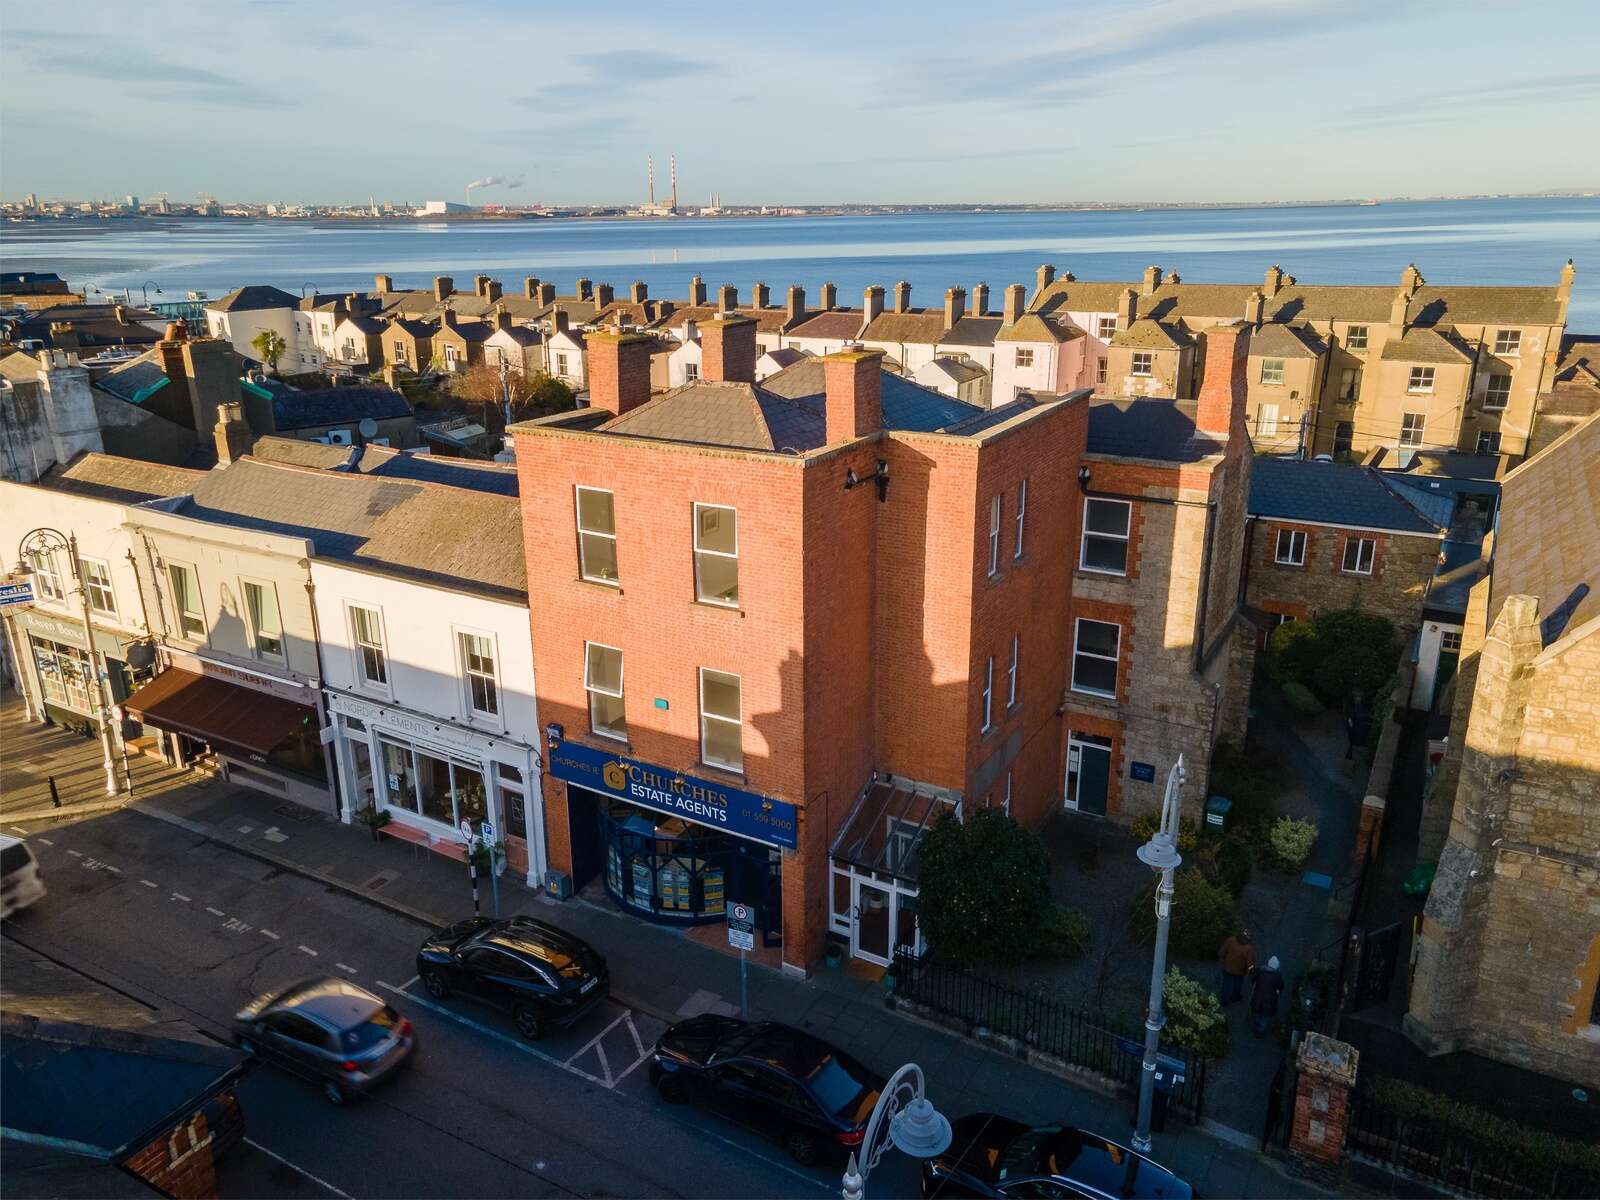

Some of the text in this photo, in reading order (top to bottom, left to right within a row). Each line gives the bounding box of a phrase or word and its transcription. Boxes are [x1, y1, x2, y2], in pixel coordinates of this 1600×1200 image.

[628, 765, 728, 808] CHURCHES
[631, 783, 727, 822] ESTATE AGENTS
